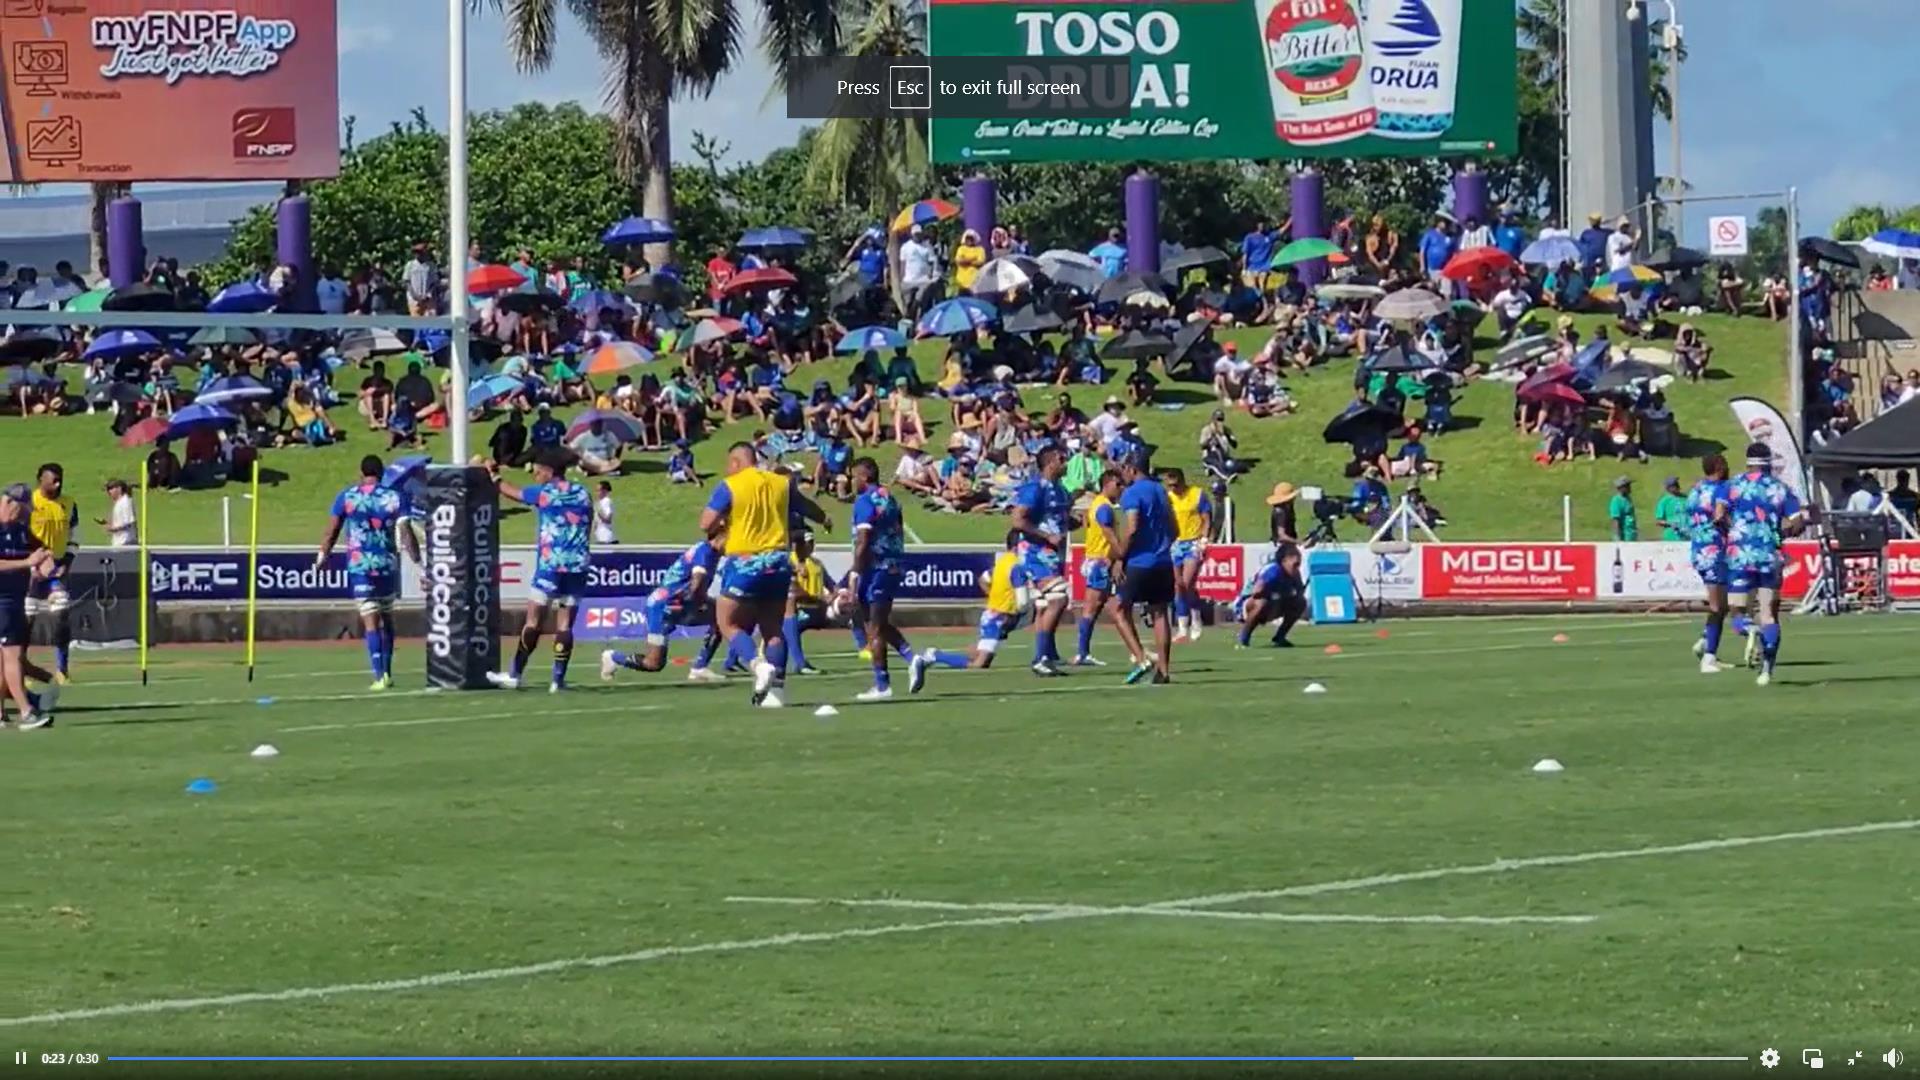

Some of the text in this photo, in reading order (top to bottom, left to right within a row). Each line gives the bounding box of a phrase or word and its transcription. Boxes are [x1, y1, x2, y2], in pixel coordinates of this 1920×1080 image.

[94, 12, 293, 48] myFNPF App
[1015, 10, 1180, 56] TOSO
[1283, 32, 1350, 60] Bitter
[103, 45, 276, 83] Just got better
[1006, 63, 1191, 109] DRUA!
[1370, 66, 1439, 89] DRUA
[246, 143, 293, 155] FNPF
[78, 162, 133, 173] Transaction
[171, 562, 238, 585] HFC
[1441, 550, 1575, 573] MOGUL
[171, 583, 213, 592] BANK
[257, 563, 349, 589] Stadiu
[427, 504, 456, 657] Buildcorp
[470, 504, 492, 657] Buildcorp
[900, 564, 975, 587] adium
[1453, 574, 1483, 585] Visual
[1484, 574, 1529, 585] Solutions
